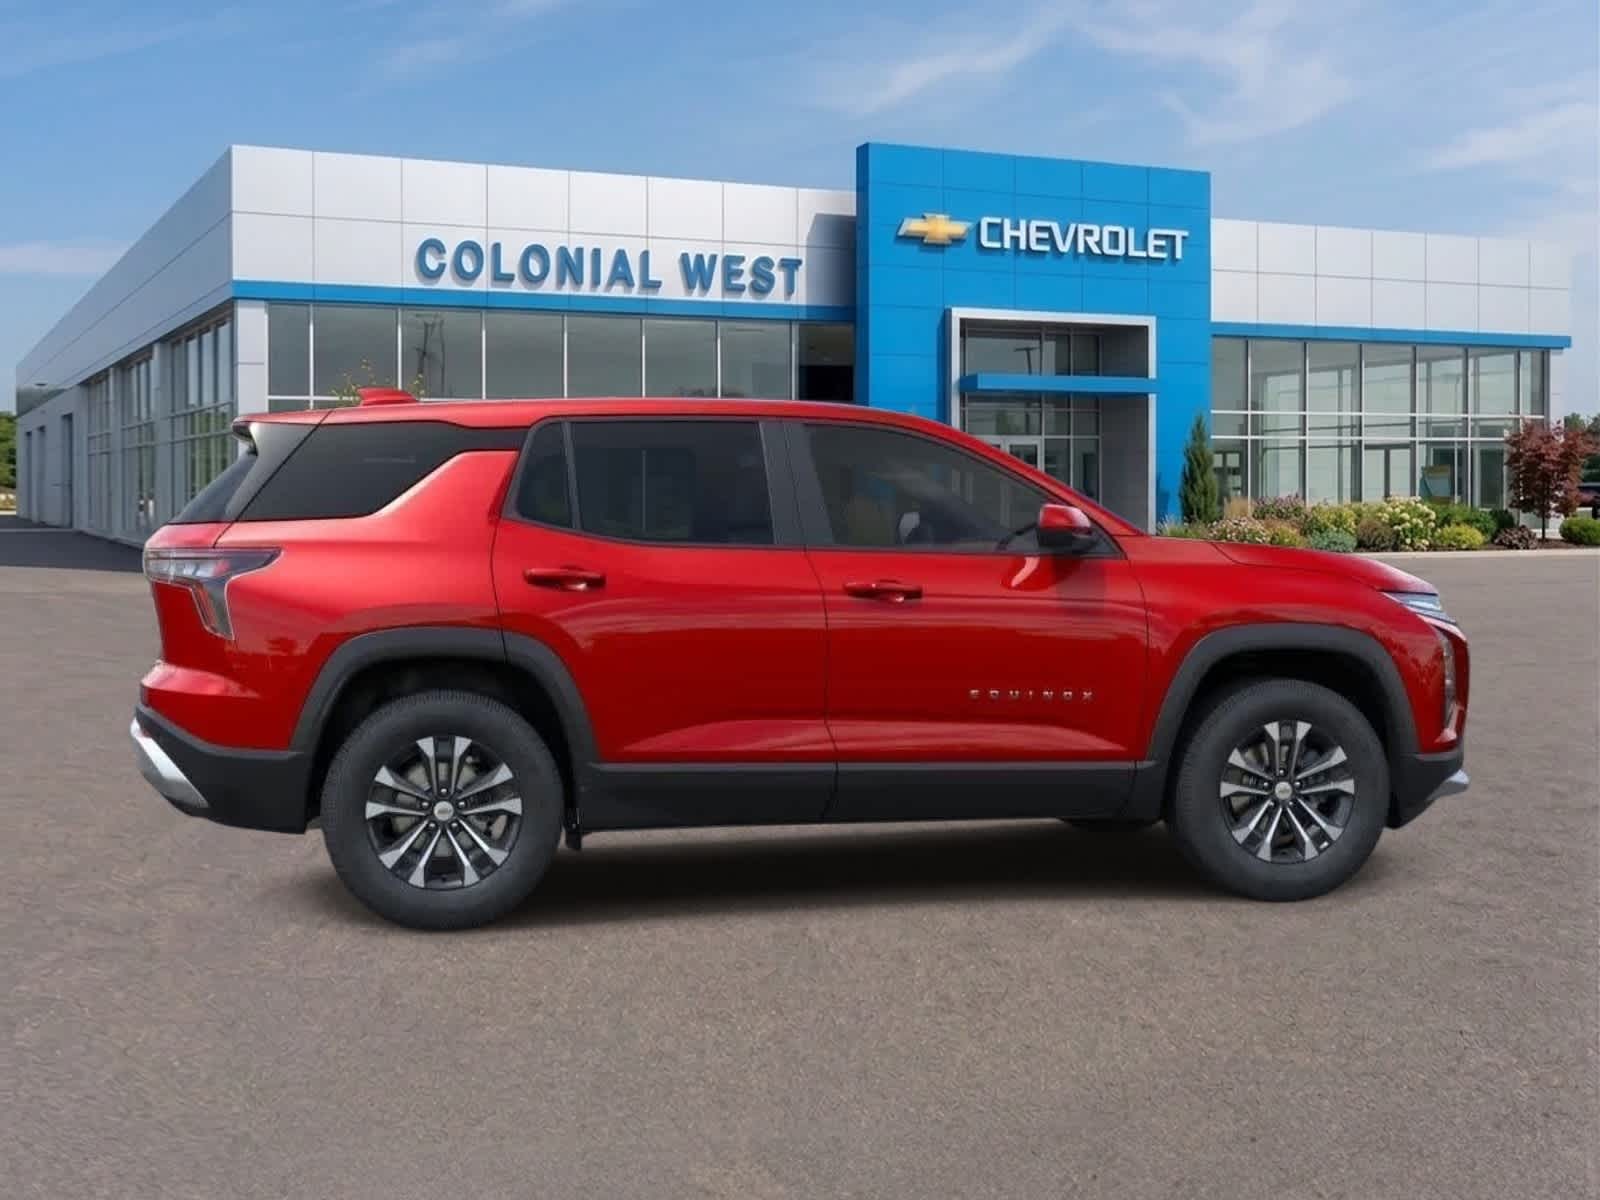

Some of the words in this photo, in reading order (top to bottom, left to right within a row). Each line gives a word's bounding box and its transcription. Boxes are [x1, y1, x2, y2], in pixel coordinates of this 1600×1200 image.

[980, 216, 1189, 260] CHEVROLET
[416, 238, 662, 289] COLONIAL
[680, 251, 803, 297] WEST
[969, 689, 1093, 701] EQUINOX
